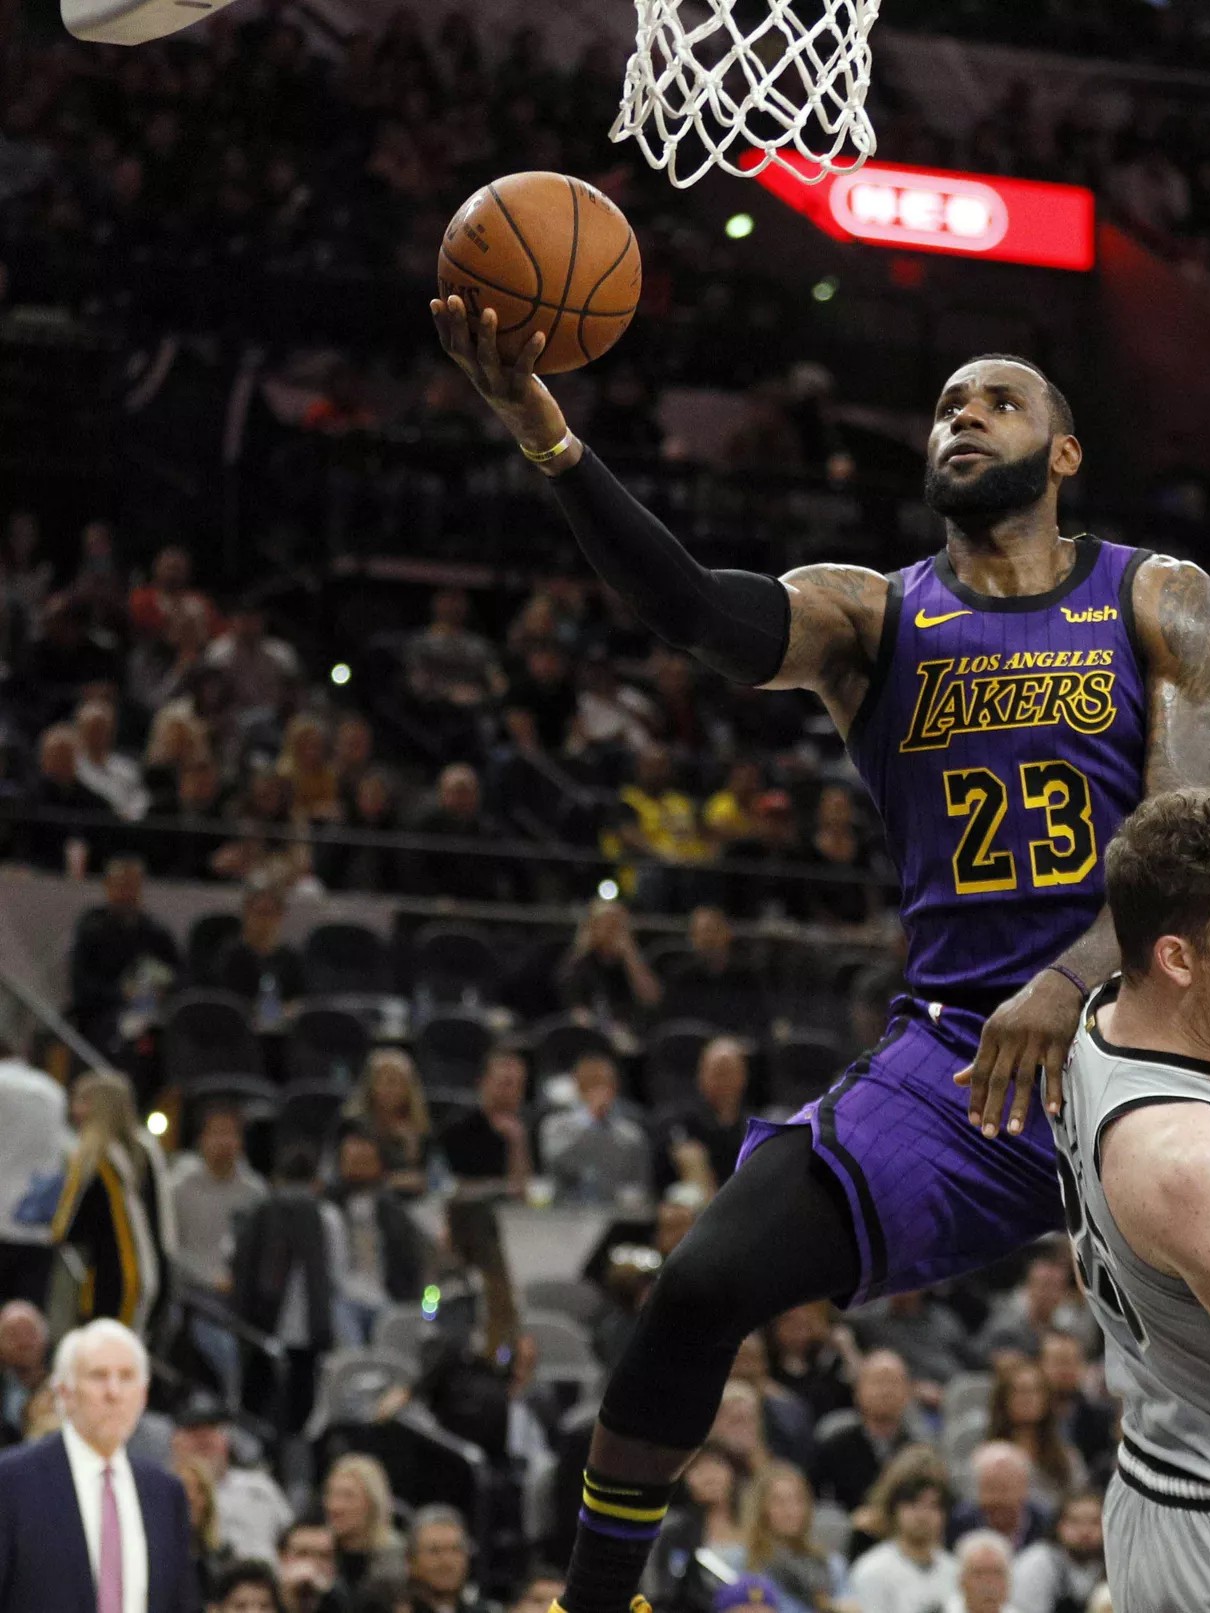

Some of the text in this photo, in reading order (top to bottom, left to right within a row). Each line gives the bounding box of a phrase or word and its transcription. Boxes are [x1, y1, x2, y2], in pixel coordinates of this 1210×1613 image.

[1060, 605, 1118, 623] wish
[955, 649, 1114, 676] LOS ANGELES
[899, 658, 1118, 753] LAKERS
[942, 759, 1098, 895] 23
